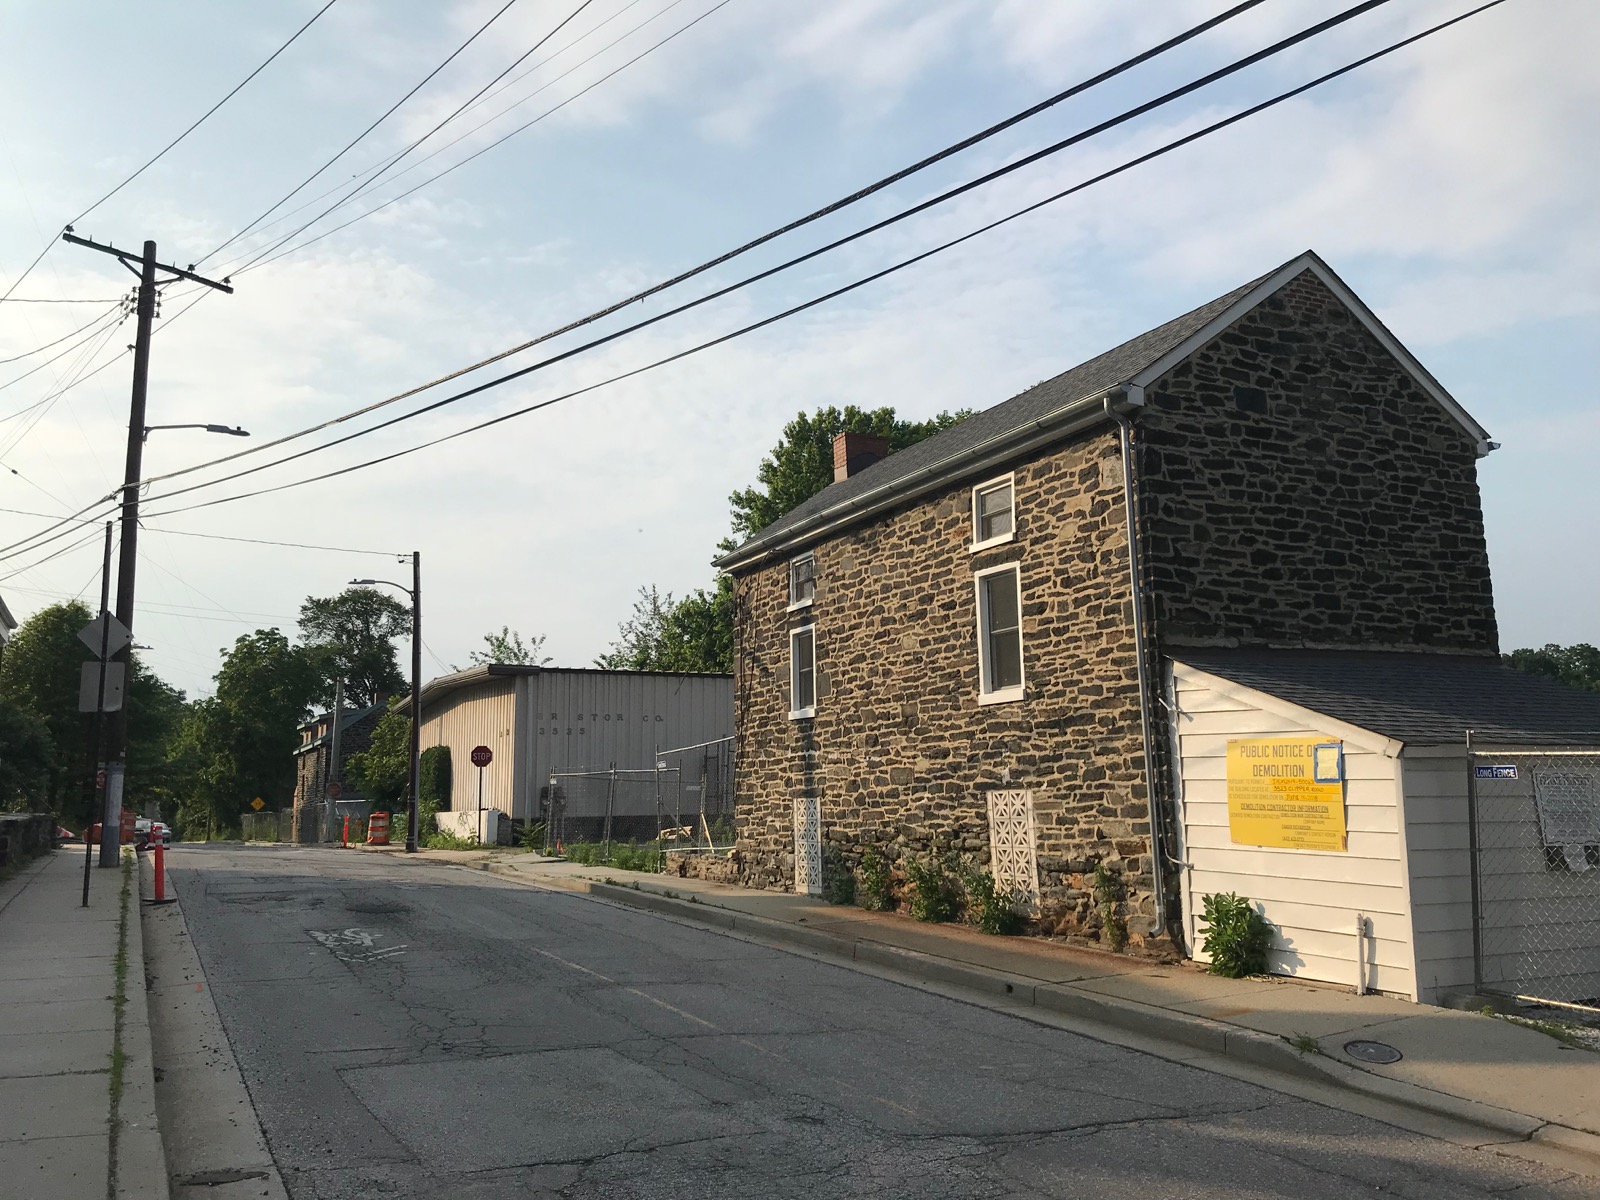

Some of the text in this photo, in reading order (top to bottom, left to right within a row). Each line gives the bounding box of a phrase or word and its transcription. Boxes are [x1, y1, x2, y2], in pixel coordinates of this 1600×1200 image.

[472, 752, 491, 761] STOP
[1240, 745, 1316, 758] PUBLIC NOTICE O
[1253, 764, 1305, 777] DEMOLITION
[1475, 767, 1516, 778] LONG FENCE
[1240, 803, 1330, 813] DEMOLITION CONTRACTOR INFORMATION
